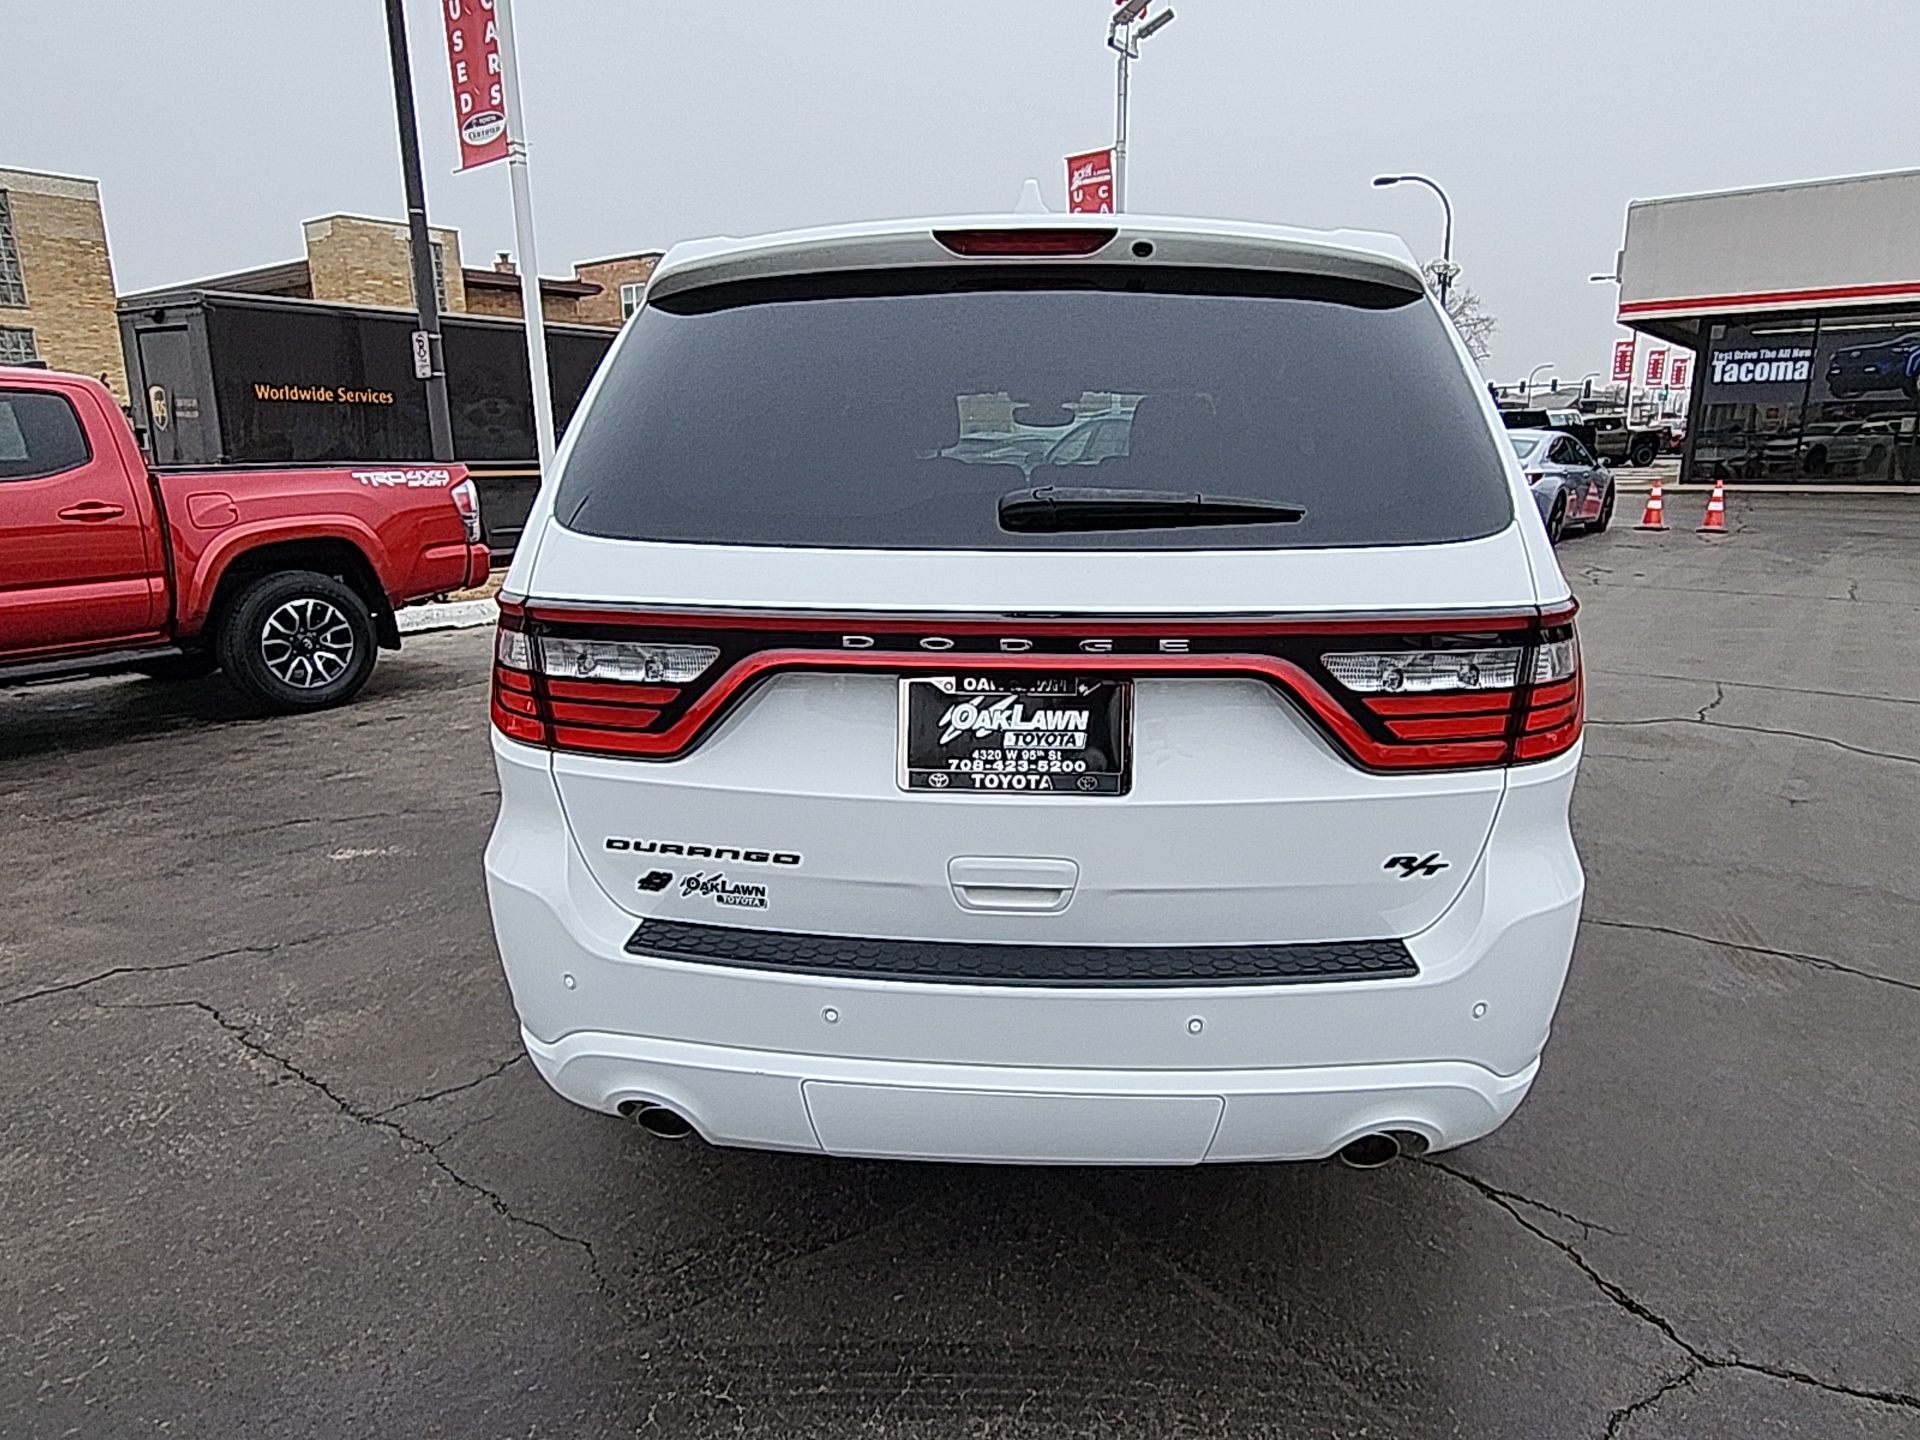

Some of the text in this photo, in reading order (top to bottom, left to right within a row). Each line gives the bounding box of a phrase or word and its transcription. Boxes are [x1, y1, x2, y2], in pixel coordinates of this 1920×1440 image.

[449, 0, 472, 114] USED
[1734, 350, 1758, 360] Drive
[1760, 349, 1776, 359] The
[1777, 348, 1791, 358] All
[1712, 360, 1810, 383] Tacoma
[254, 383, 394, 404] Worldwide Services
[351, 471, 407, 487] TRD
[842, 635, 1190, 652] DODGE
[1012, 732, 1078, 747] TOYOTA
[972, 749, 1062, 760] 4320 W 95th St
[948, 759, 1087, 772] 708-423-5200
[971, 774, 1053, 790] TOYOTA
[605, 838, 801, 865] DURANGO
[1383, 852, 1450, 878] R/T
[722, 895, 761, 907] TOYOTA
